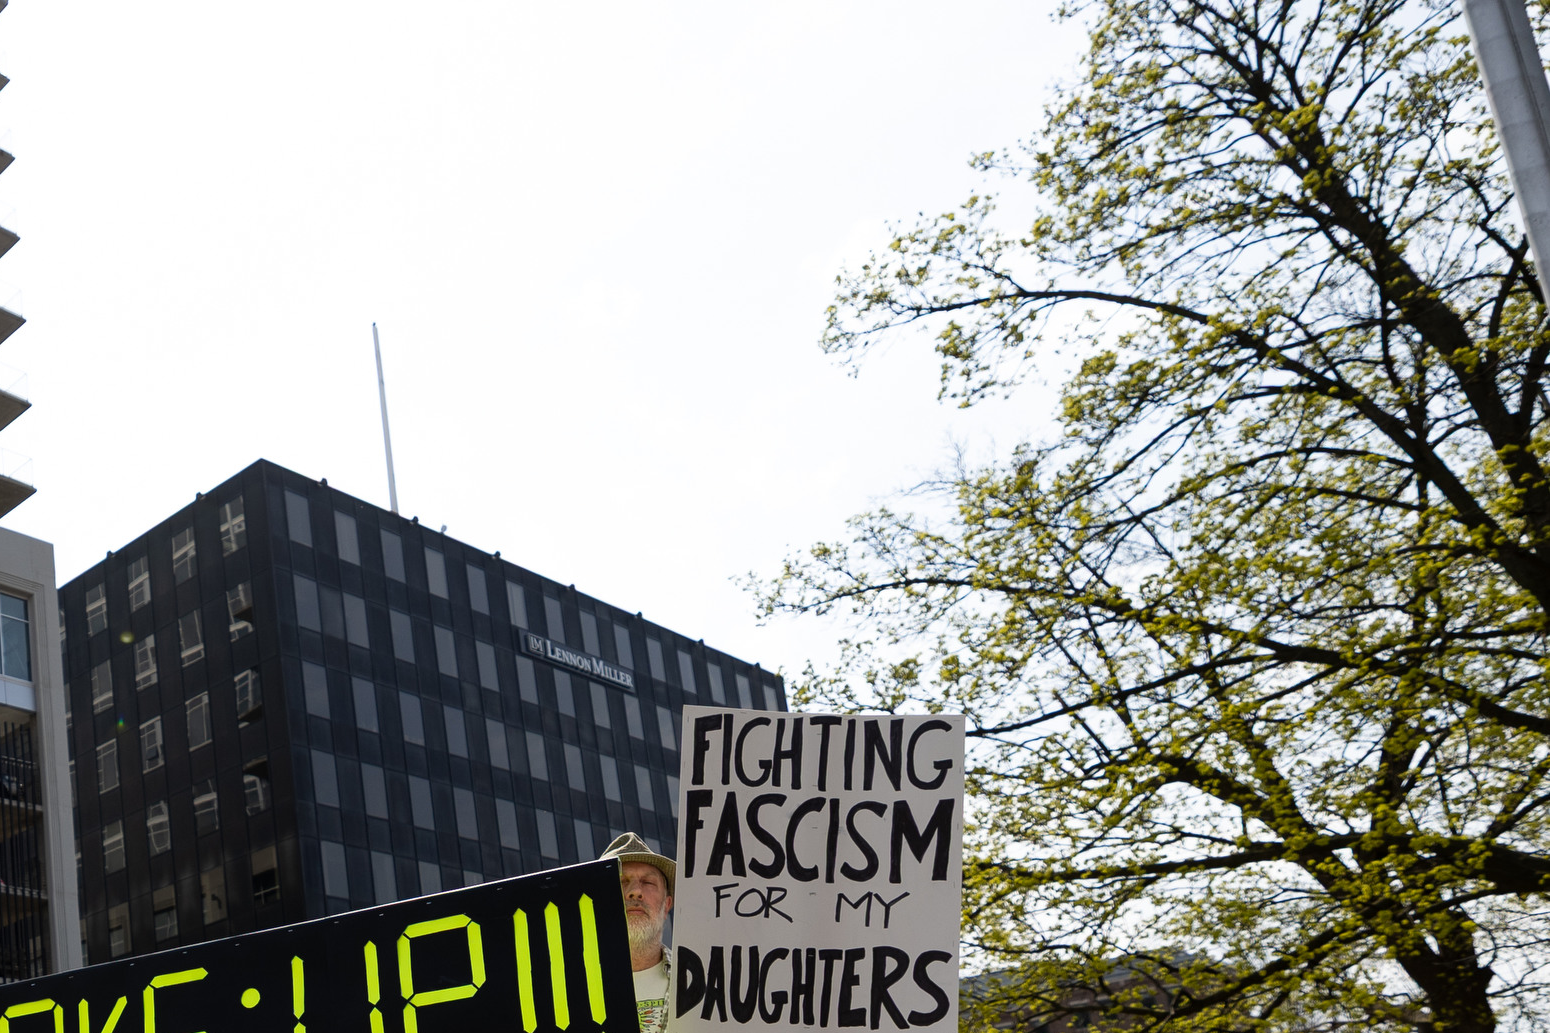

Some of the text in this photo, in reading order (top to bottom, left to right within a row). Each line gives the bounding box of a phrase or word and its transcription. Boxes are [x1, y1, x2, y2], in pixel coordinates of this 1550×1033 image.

[545, 639, 633, 688] LENNON MILLER
[691, 713, 953, 792] FIGHTING
[684, 789, 955, 884] FASCISM
[713, 883, 910, 929] FOR MY
[676, 945, 953, 1030] DAUGHTERS
